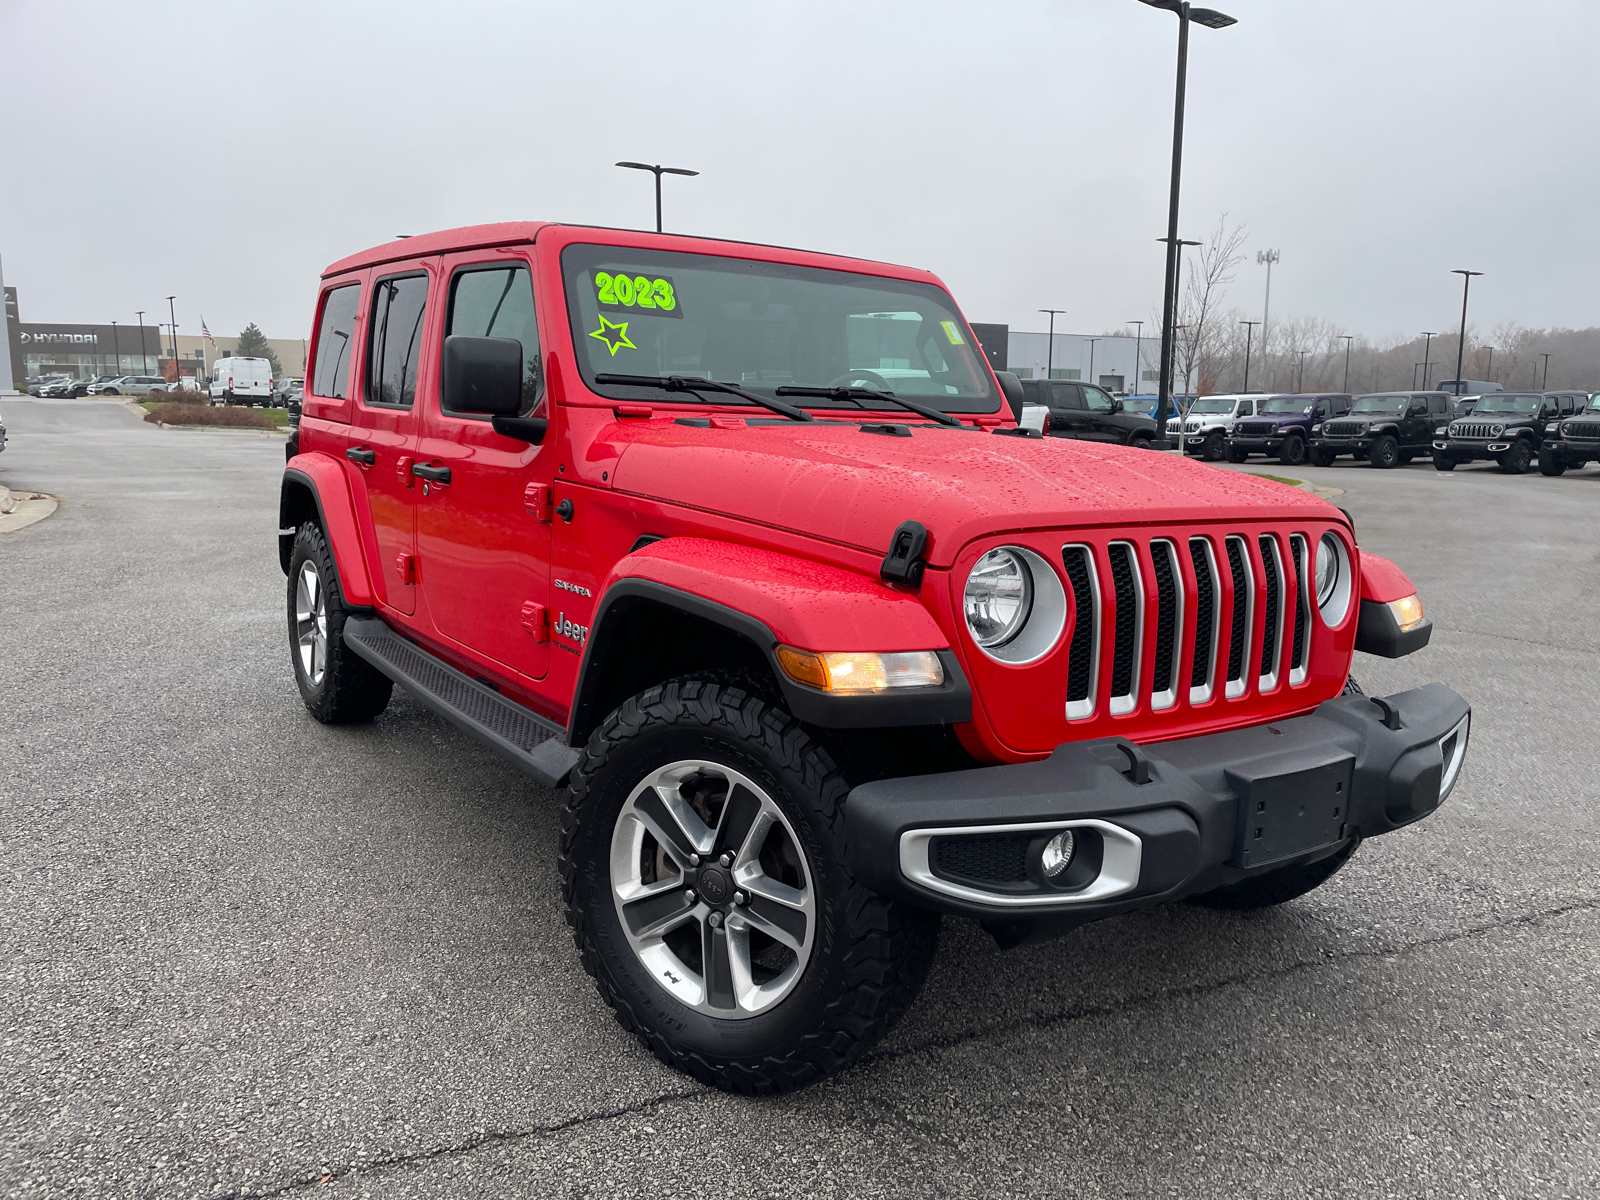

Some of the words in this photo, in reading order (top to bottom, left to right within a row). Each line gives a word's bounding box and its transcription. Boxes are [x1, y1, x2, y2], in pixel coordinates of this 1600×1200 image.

[595, 271, 676, 311] 2023
[34, 333, 98, 344] HYUNDAI
[554, 579, 592, 598] SAHARA
